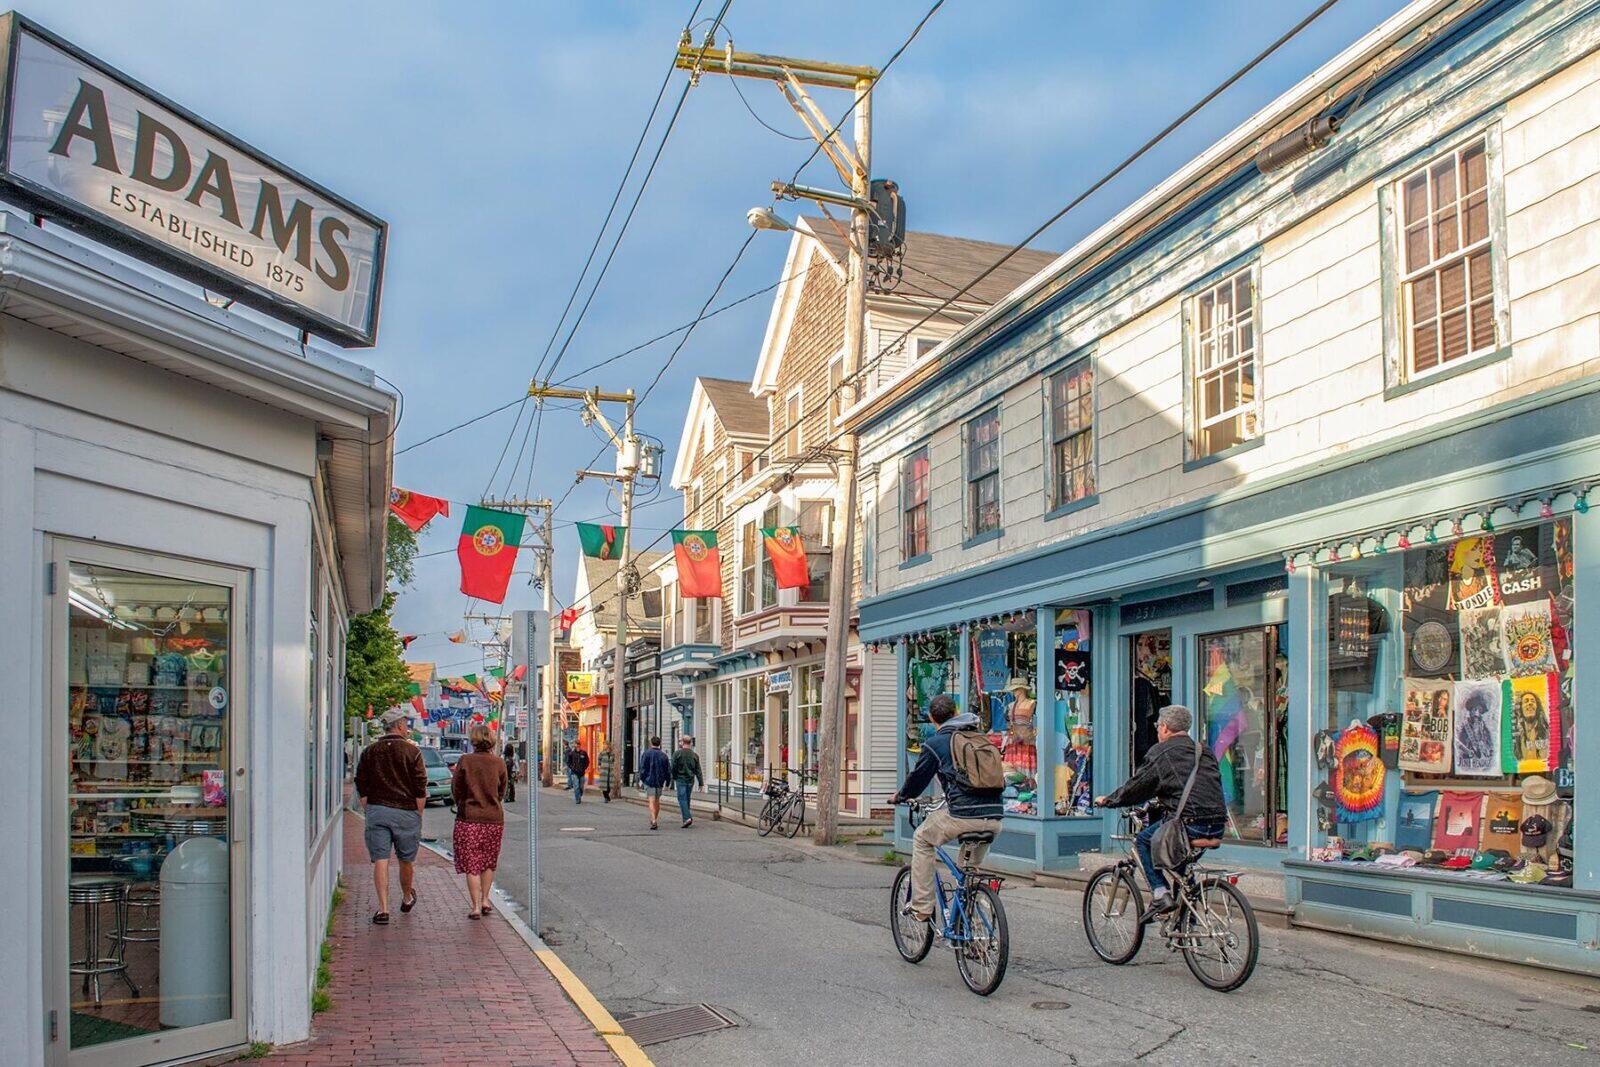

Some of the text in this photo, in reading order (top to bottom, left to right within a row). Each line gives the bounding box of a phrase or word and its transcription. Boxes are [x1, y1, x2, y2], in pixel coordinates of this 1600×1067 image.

[48, 77, 350, 291] ADAMS
[109, 185, 304, 293] ESTABLISHED 1875
[1501, 576, 1541, 595] CASH
[1430, 718, 1449, 733] BOB
